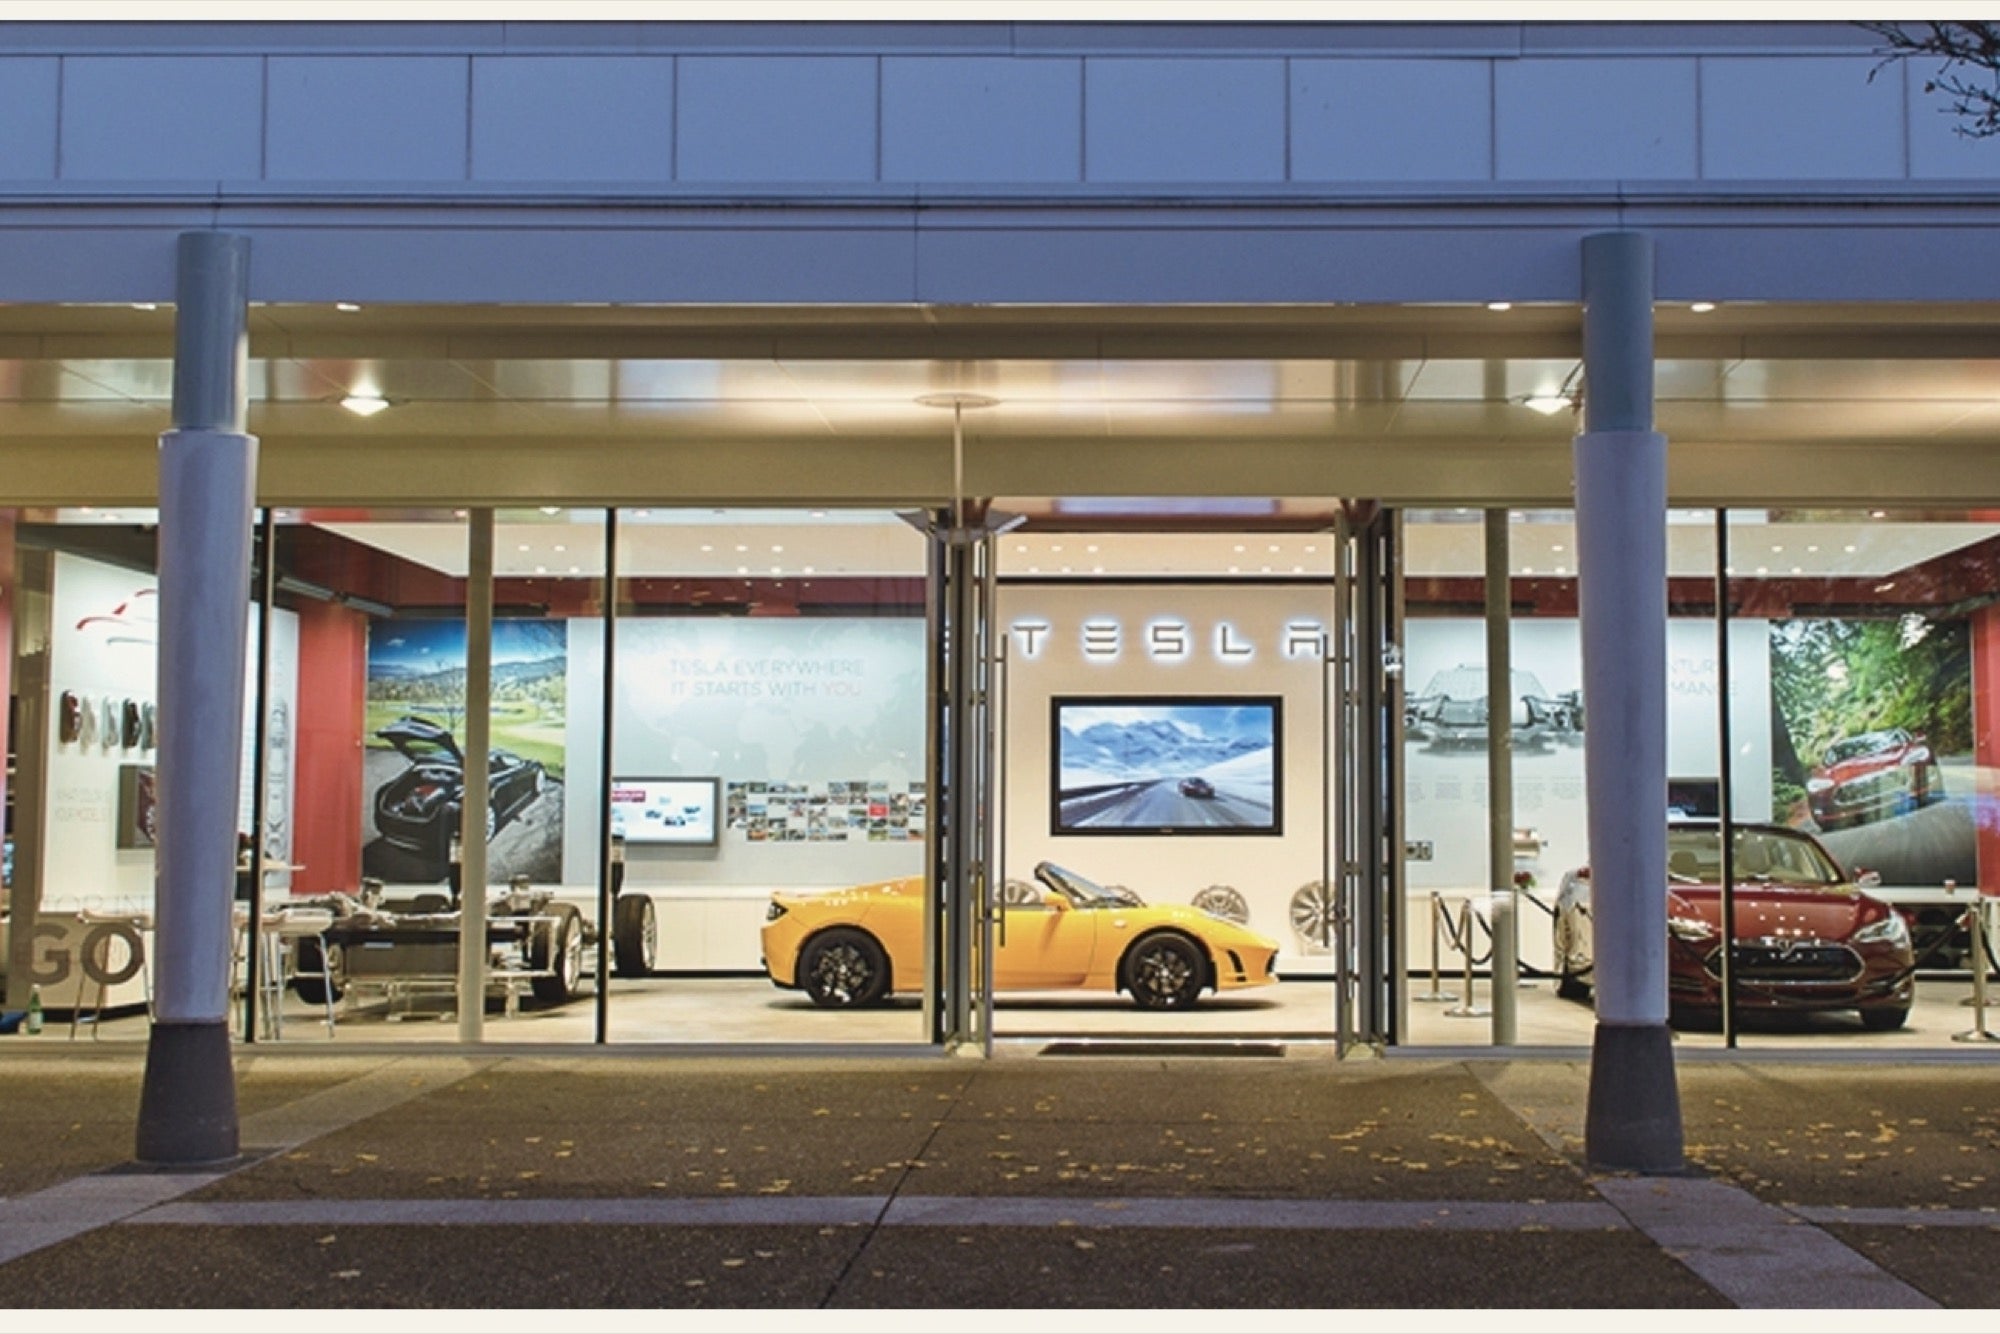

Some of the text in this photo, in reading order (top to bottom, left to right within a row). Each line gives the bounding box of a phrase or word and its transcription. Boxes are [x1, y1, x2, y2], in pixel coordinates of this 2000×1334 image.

[1011, 624, 1322, 656] TESLA
[669, 658, 865, 676] TESLA EVERYWHERE
[670, 680, 863, 697] IT STARTS WITH YOU
